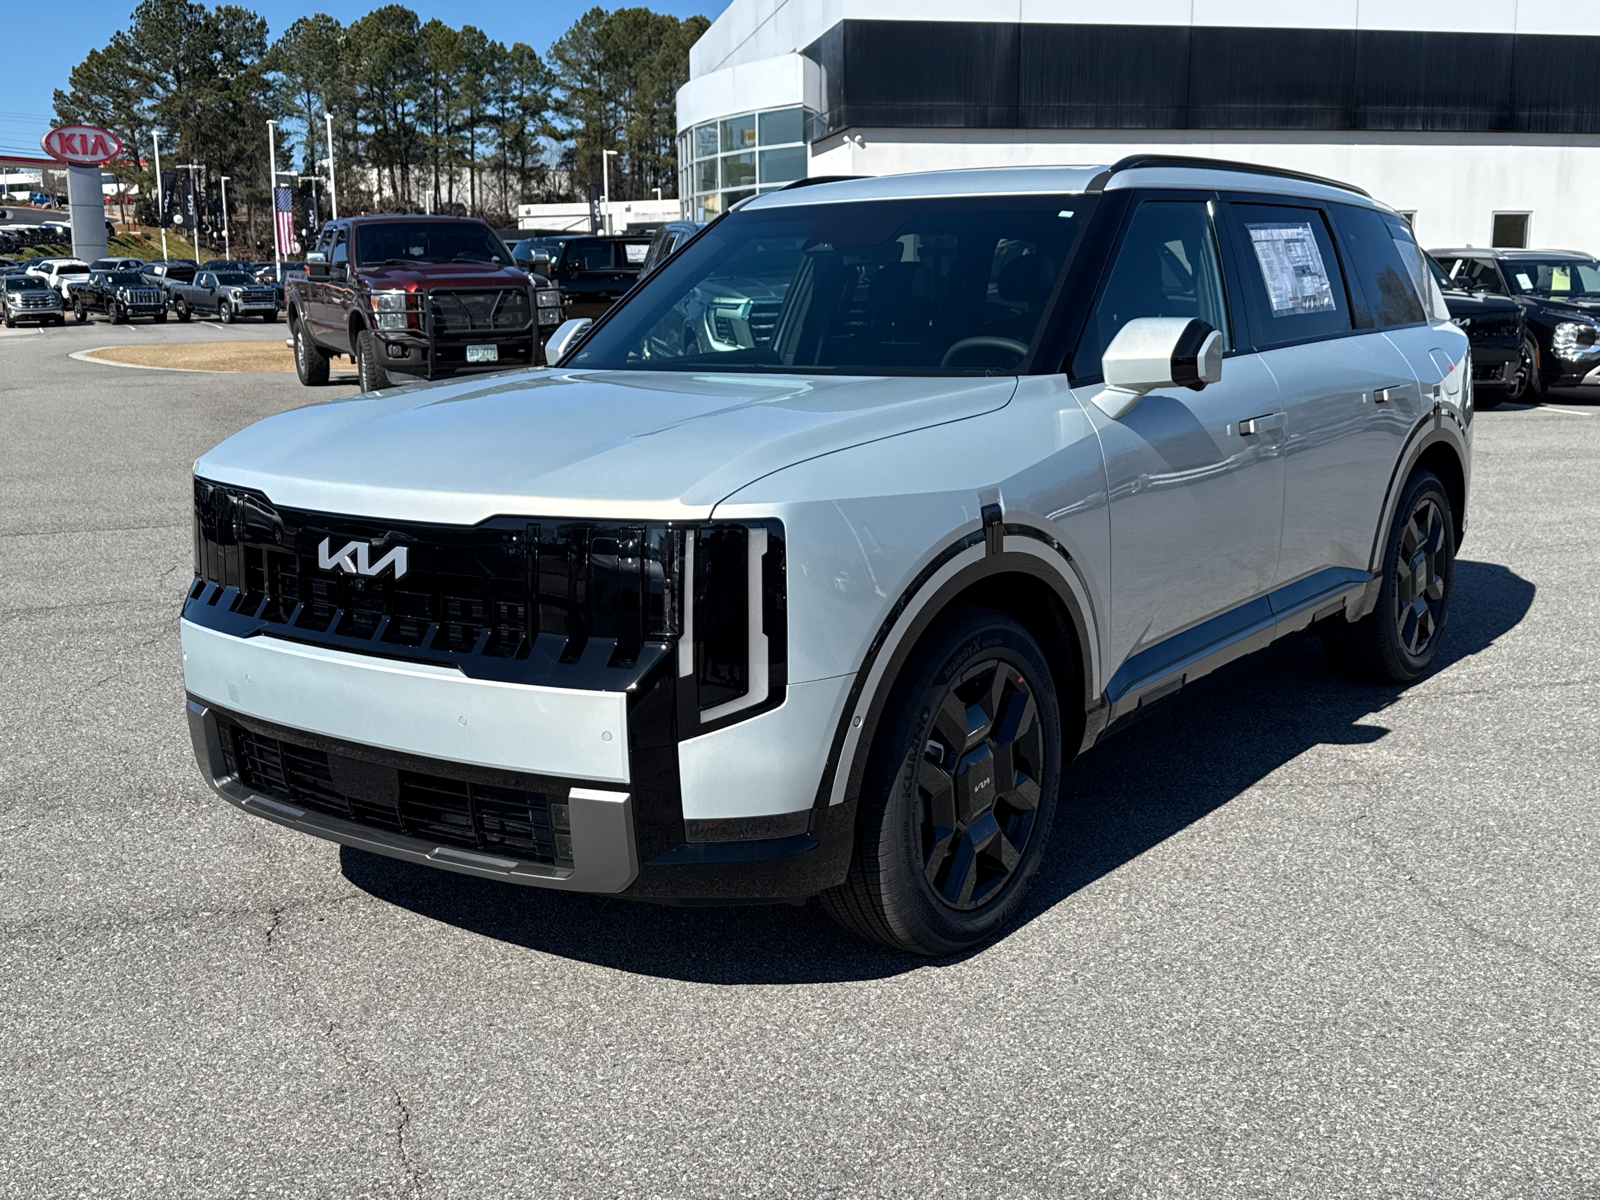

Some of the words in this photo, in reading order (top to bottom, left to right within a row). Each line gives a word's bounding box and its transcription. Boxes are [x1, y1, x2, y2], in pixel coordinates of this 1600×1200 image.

[58, 132, 111, 157] KIA
[318, 536, 409, 580] KIA
[901, 705, 931, 799] KUMHO
